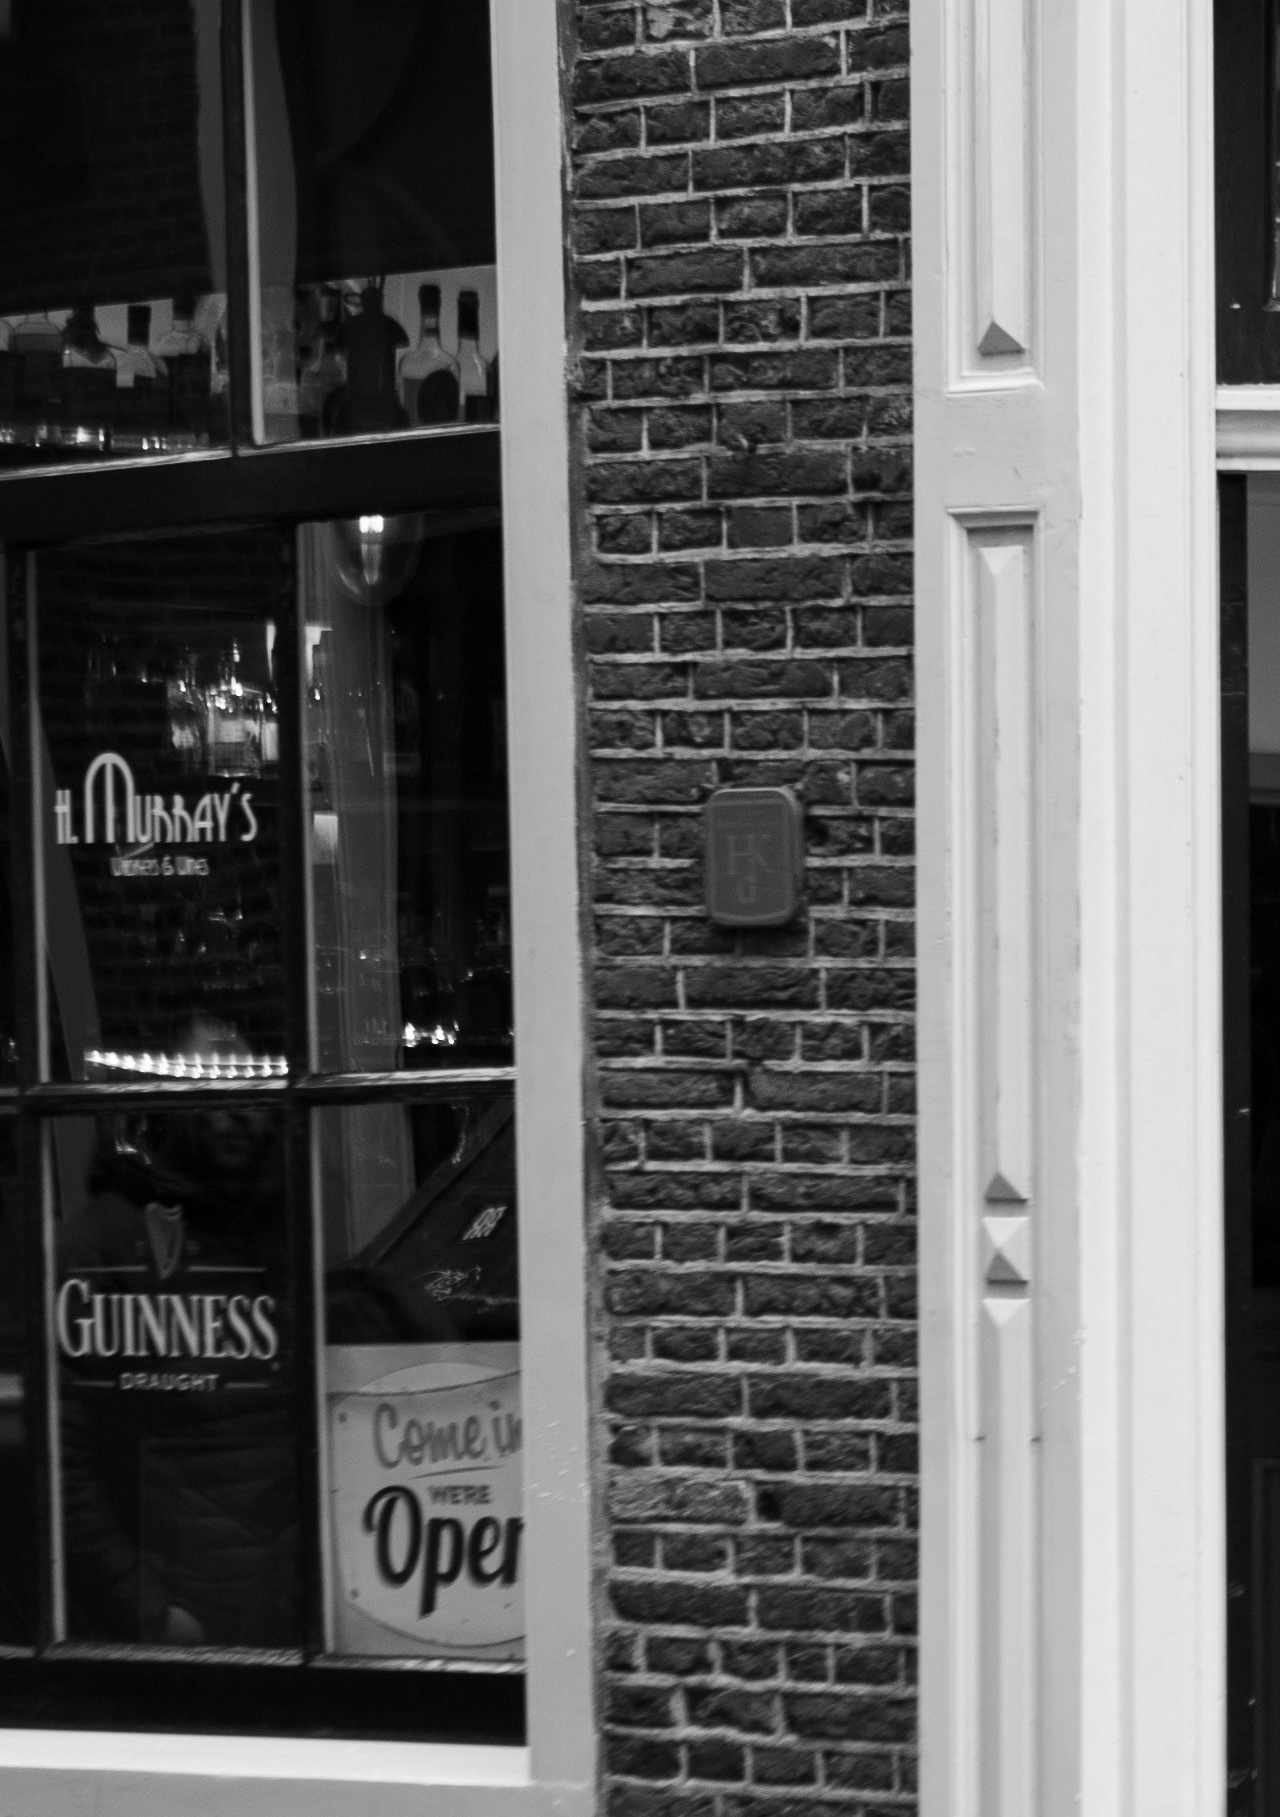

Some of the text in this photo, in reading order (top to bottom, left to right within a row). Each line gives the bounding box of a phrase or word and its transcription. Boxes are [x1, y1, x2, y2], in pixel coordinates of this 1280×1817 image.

[56, 1278, 278, 1362] GUINNESS
[119, 1372, 219, 1392] DRAUGHT
[373, 1402, 487, 1469] Come
